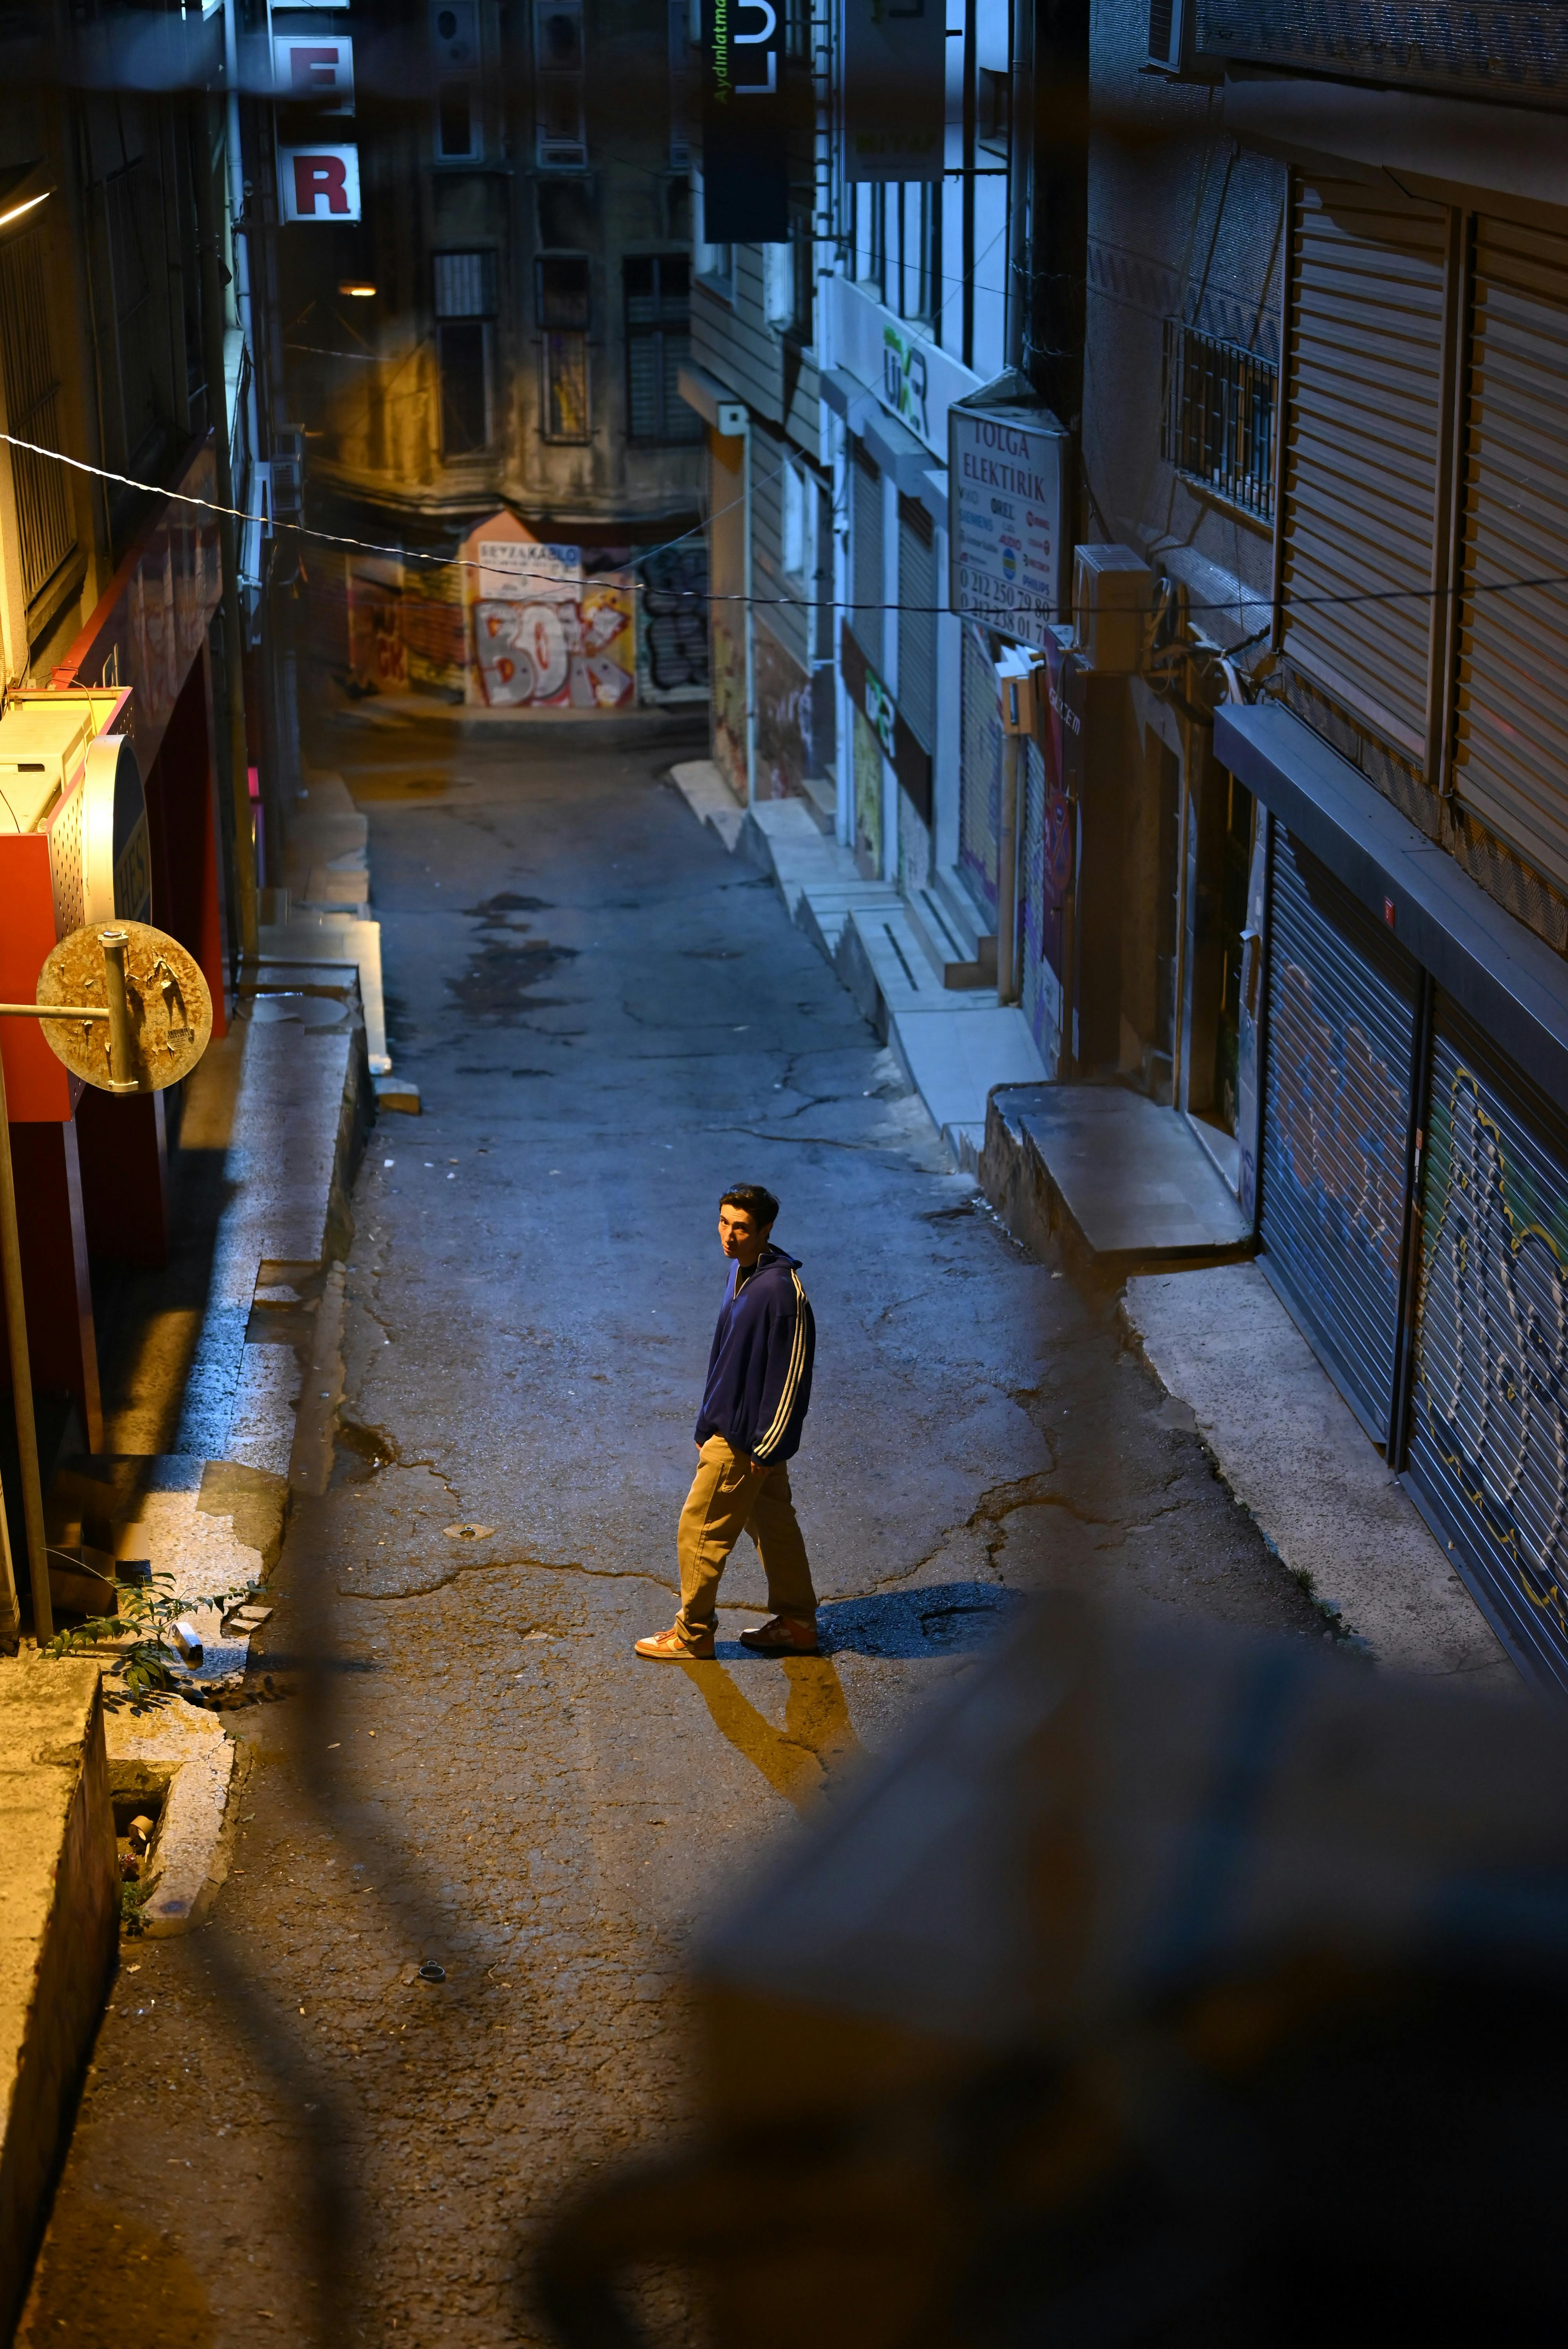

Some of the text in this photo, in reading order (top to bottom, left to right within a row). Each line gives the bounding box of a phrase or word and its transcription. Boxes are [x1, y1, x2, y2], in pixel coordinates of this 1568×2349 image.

[975, 419, 1030, 460] TOLGA
[964, 452, 1046, 503] ELEKTİRİK
[960, 568, 1050, 622] 0 212 250 79 80
[1022, 575, 1050, 596] PHILIPS
[971, 597, 991, 622] 212
[1017, 616, 1030, 639] 01
